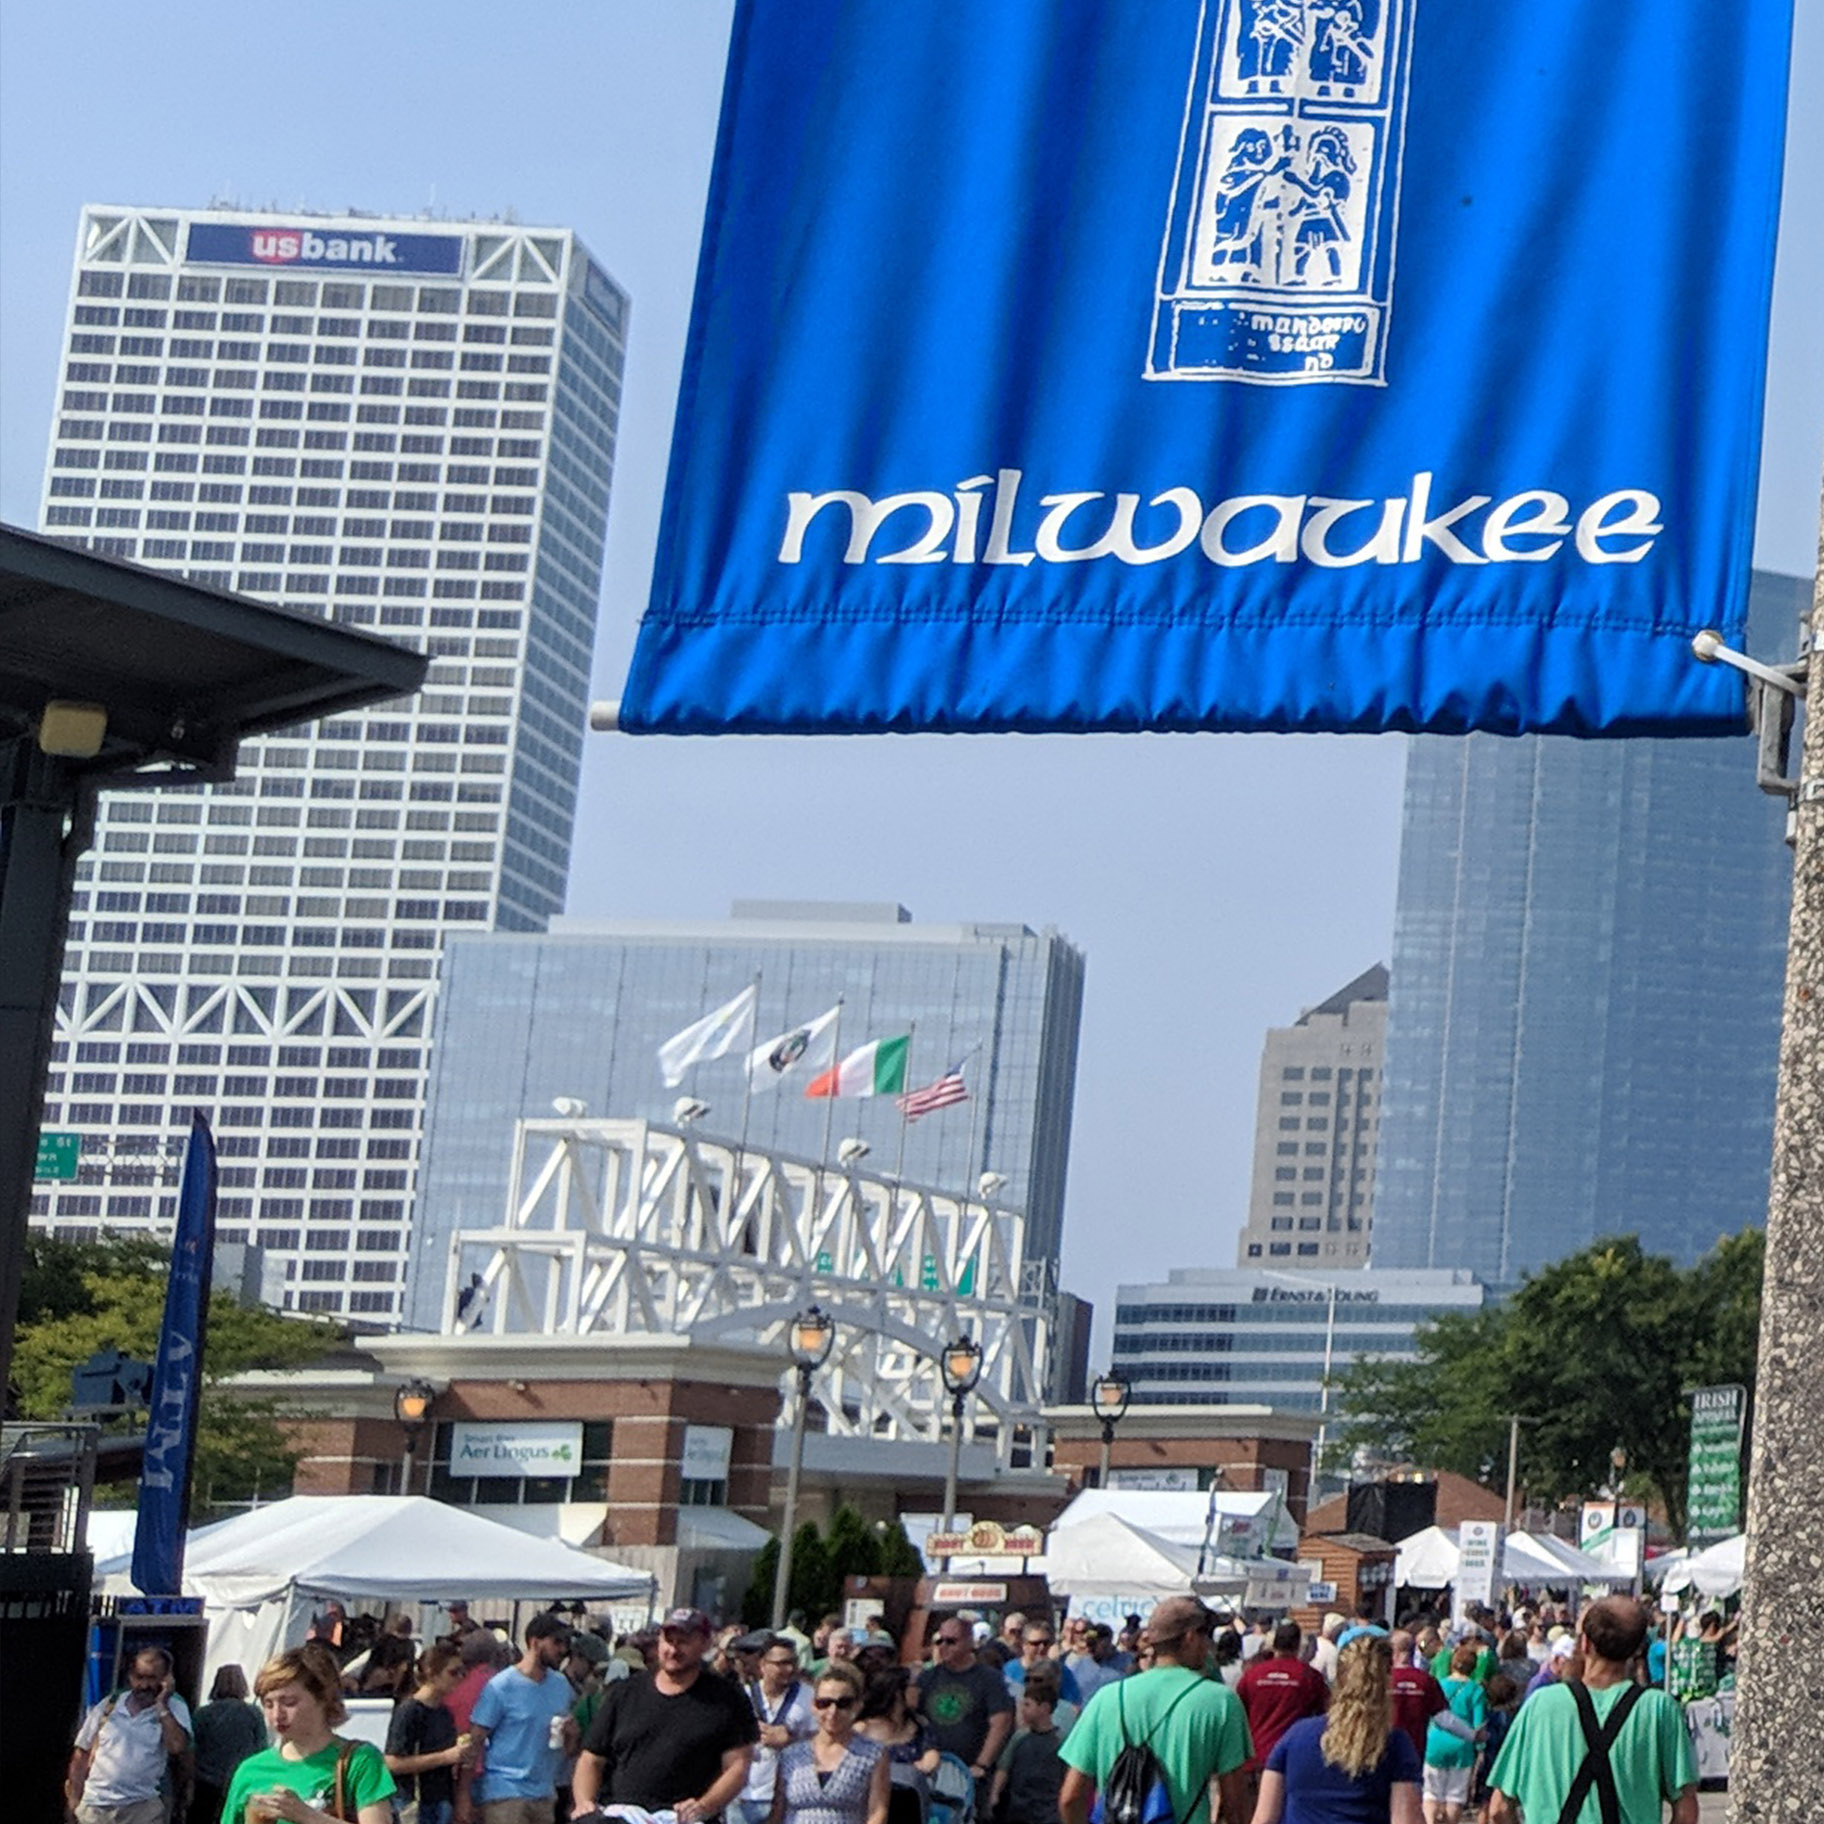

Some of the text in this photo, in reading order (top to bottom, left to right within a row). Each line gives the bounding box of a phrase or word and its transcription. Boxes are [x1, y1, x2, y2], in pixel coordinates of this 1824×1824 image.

[1693, 1389, 1738, 1409] IRISH
[459, 1442, 549, 1462] Aer Lingus
